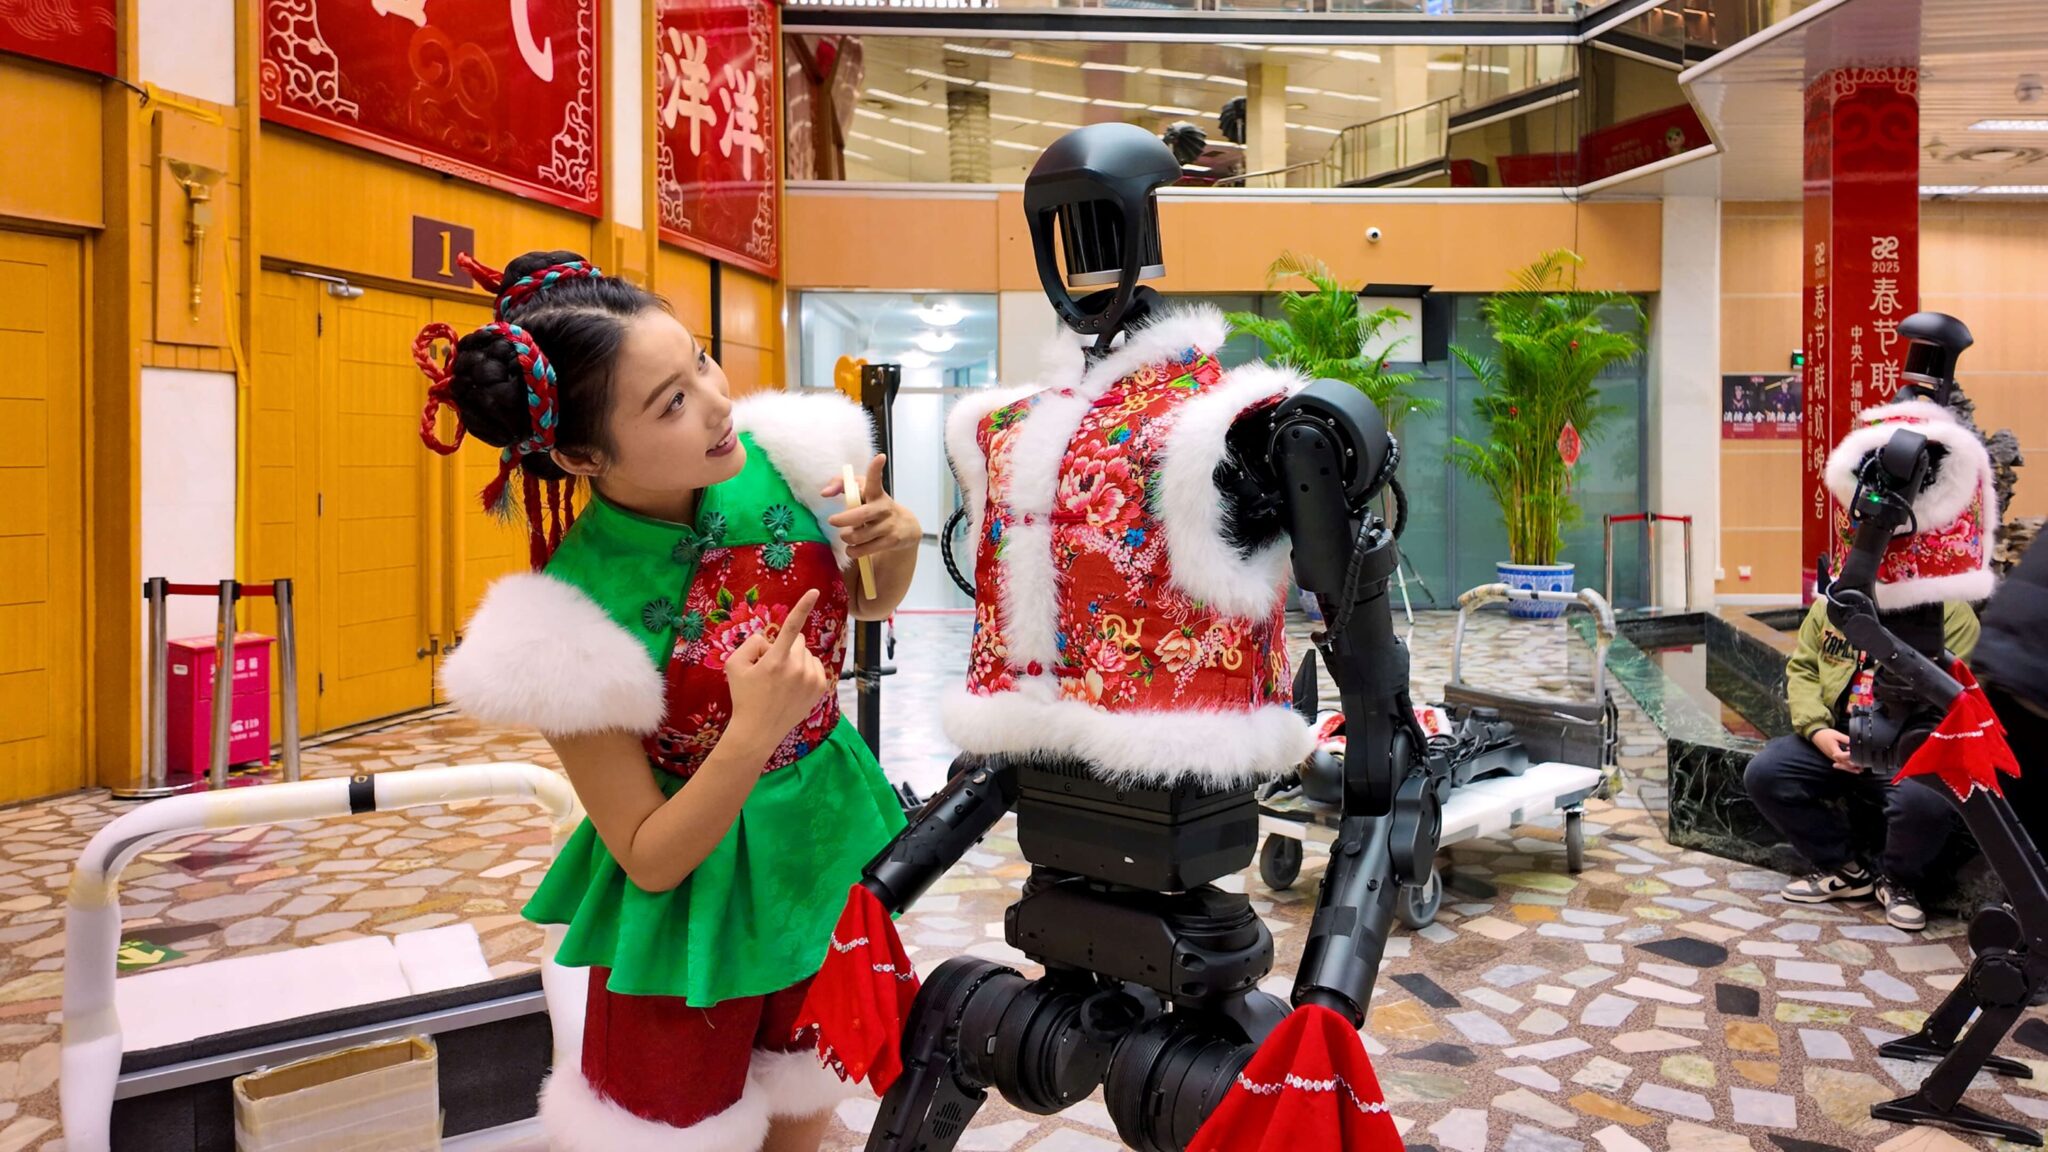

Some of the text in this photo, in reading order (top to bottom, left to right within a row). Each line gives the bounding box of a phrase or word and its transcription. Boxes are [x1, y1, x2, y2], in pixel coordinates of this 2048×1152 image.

[663, 27, 764, 181] 洋洋
[438, 231, 454, 278] 1
[1872, 261, 1900, 273] 2025
[1813, 284, 1826, 519] 春节联欢晚会
[1869, 277, 1902, 408] 春节联
